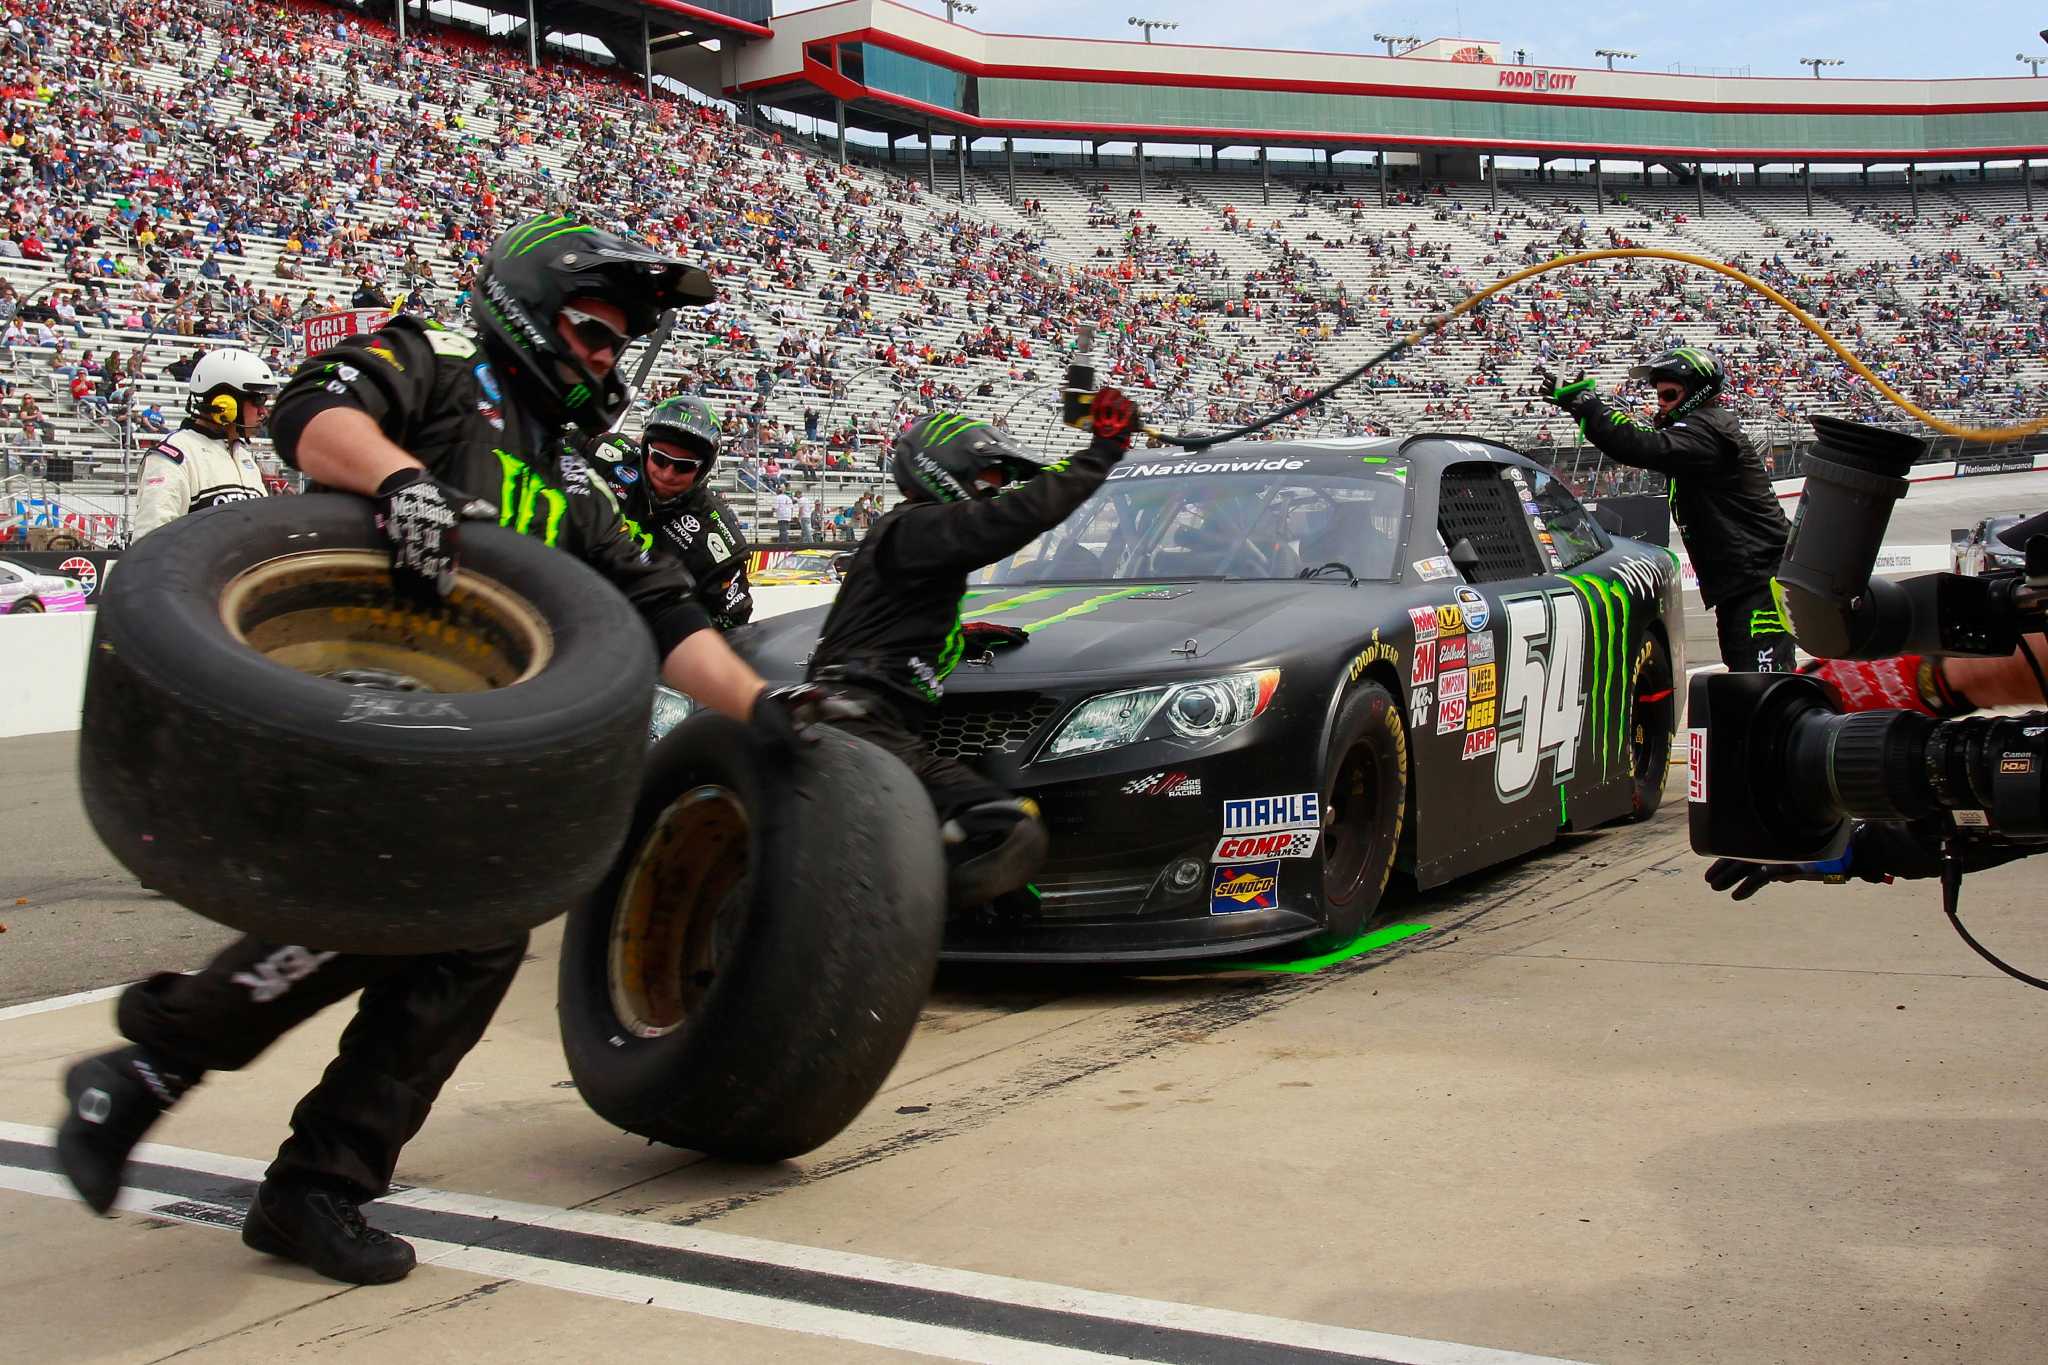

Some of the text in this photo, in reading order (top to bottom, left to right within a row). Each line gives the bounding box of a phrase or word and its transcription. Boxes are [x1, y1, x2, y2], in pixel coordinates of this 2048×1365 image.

[1499, 71, 1533, 87] FOOD
[1549, 73, 1577, 90] CITY
[309, 316, 348, 337] GRIT
[1131, 458, 1305, 478] Nationwide
[1965, 462, 2032, 474] Nationwide Insurance
[671, 520, 694, 544] TOYOTA
[726, 592, 747, 610] TOYOTA
[1412, 643, 1435, 683] 3M
[1440, 673, 1465, 696] SIMPSON
[1495, 588, 1587, 804] 54
[1440, 699, 1465, 724] MSD
[1466, 700, 1495, 731] JEGS
[1464, 728, 1496, 754] ARP
[1690, 732, 1702, 799] ESPN
[2003, 751, 2032, 759] Canon
[1174, 784, 1201, 792] GIBBS
[1182, 778, 1201, 786] JOE
[1168, 789, 1202, 798] RACING
[1226, 794, 1318, 829] MAHLE
[1218, 834, 1293, 858] COMP
[1267, 848, 1301, 858] CAMS
[1218, 878, 1273, 895] SUNOCO
